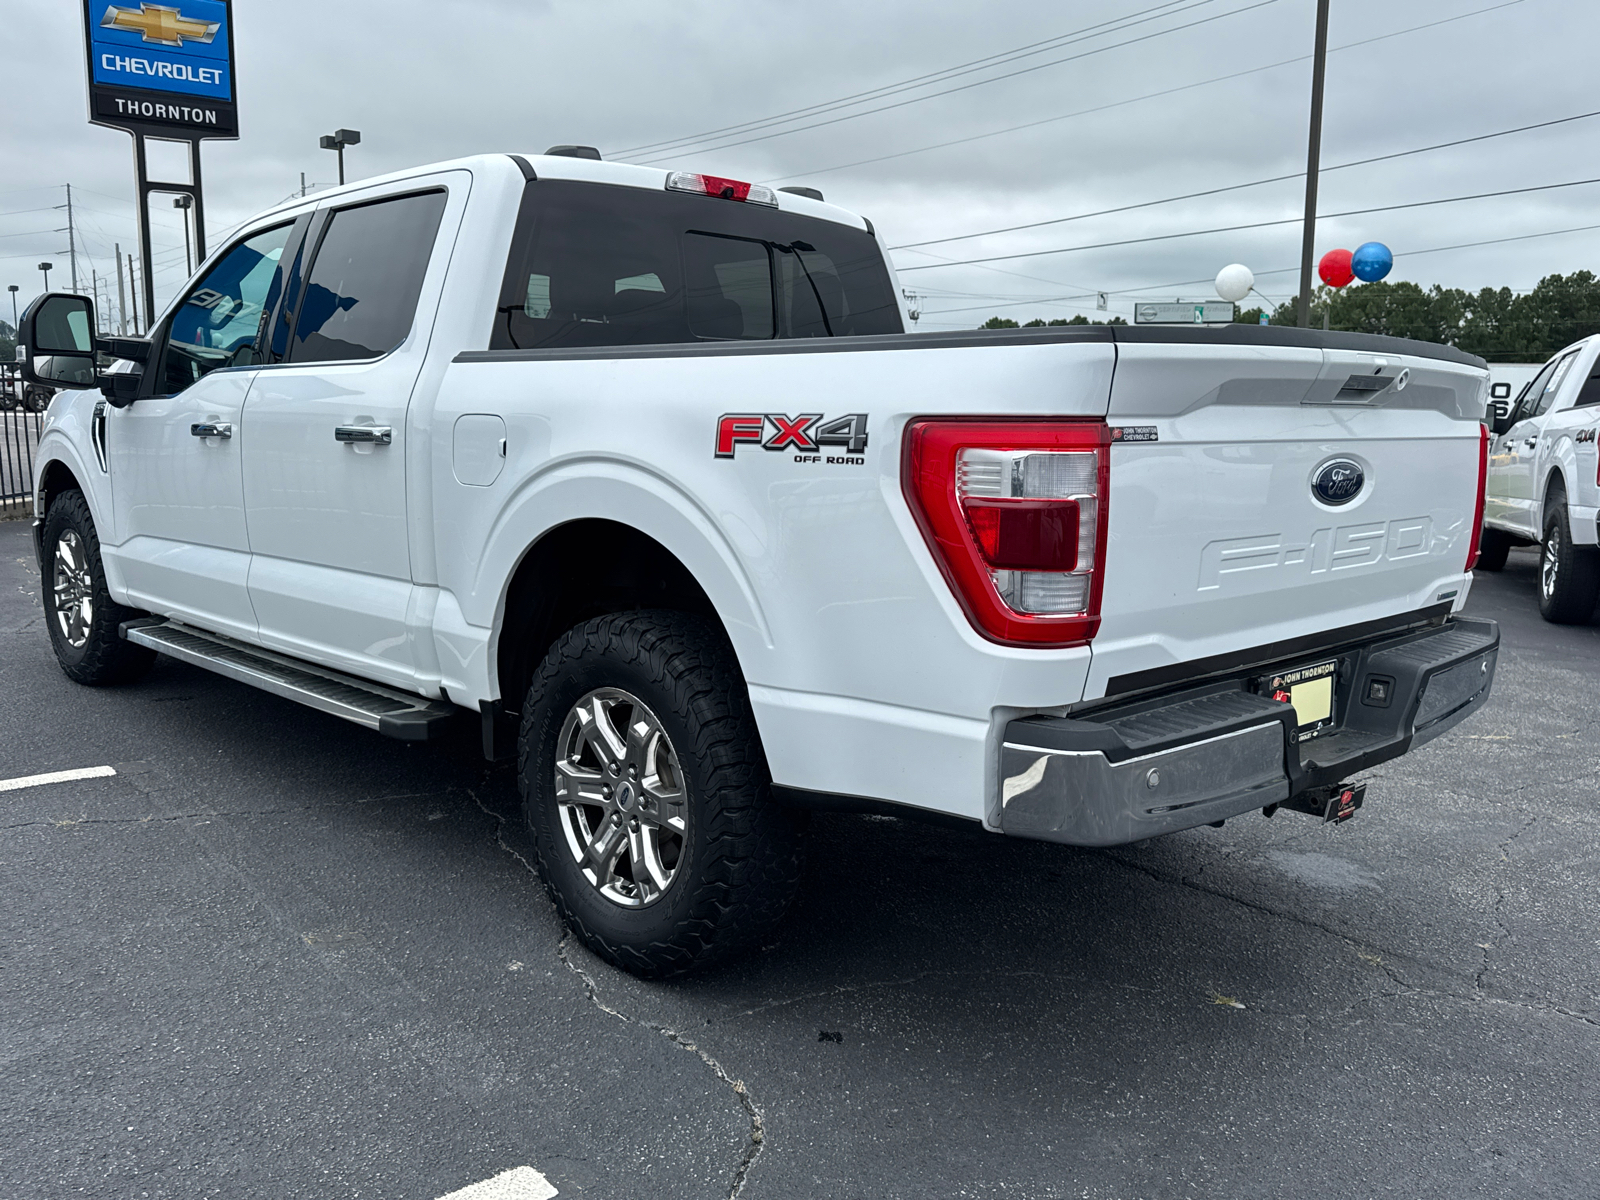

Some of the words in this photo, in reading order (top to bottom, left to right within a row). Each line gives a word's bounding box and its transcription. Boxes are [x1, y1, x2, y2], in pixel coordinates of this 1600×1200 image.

[101, 53, 223, 85] CHEVROLET
[115, 98, 217, 125] THORNTON
[713, 412, 869, 460] FX4
[794, 455, 822, 463] OFF
[826, 456, 865, 465] ROAD
[1327, 468, 1358, 495] Ford
[1197, 515, 1434, 592] F-150
[1284, 672, 1300, 683] JOHN
[1301, 663, 1334, 679] THORNTON
